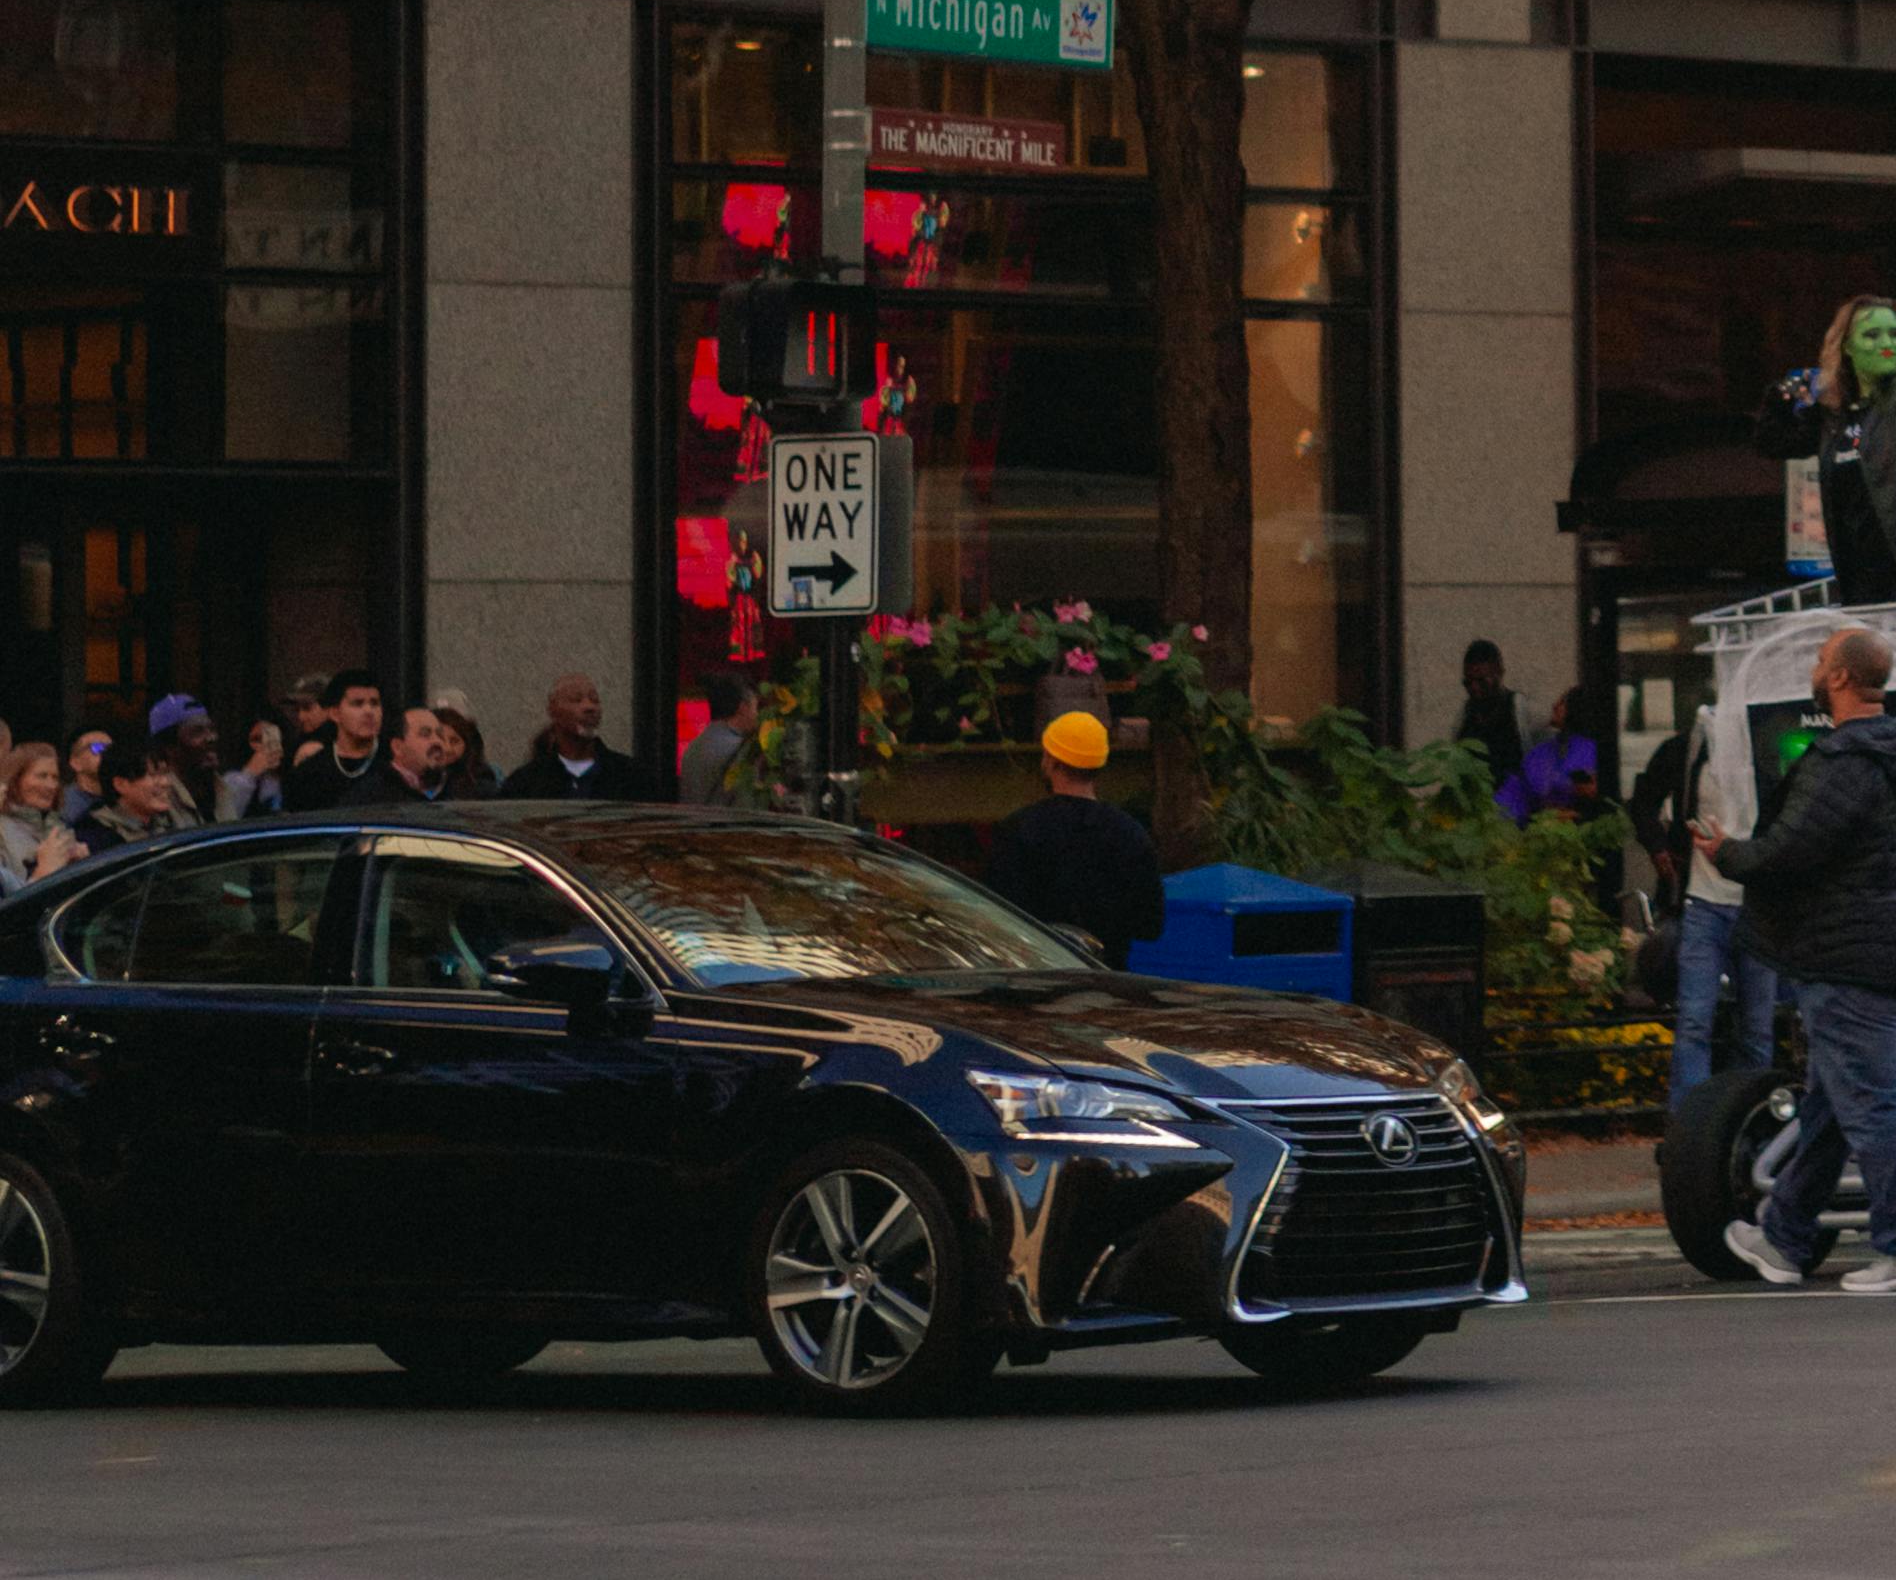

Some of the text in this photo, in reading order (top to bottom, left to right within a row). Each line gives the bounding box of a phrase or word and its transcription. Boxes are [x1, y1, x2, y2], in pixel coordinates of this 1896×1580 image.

[1032, 7, 1051, 31] Av
[880, 126, 1057, 167] THE MAGNIFICENT MILE
[785, 452, 863, 493] ONE
[783, 500, 864, 542] WAY
